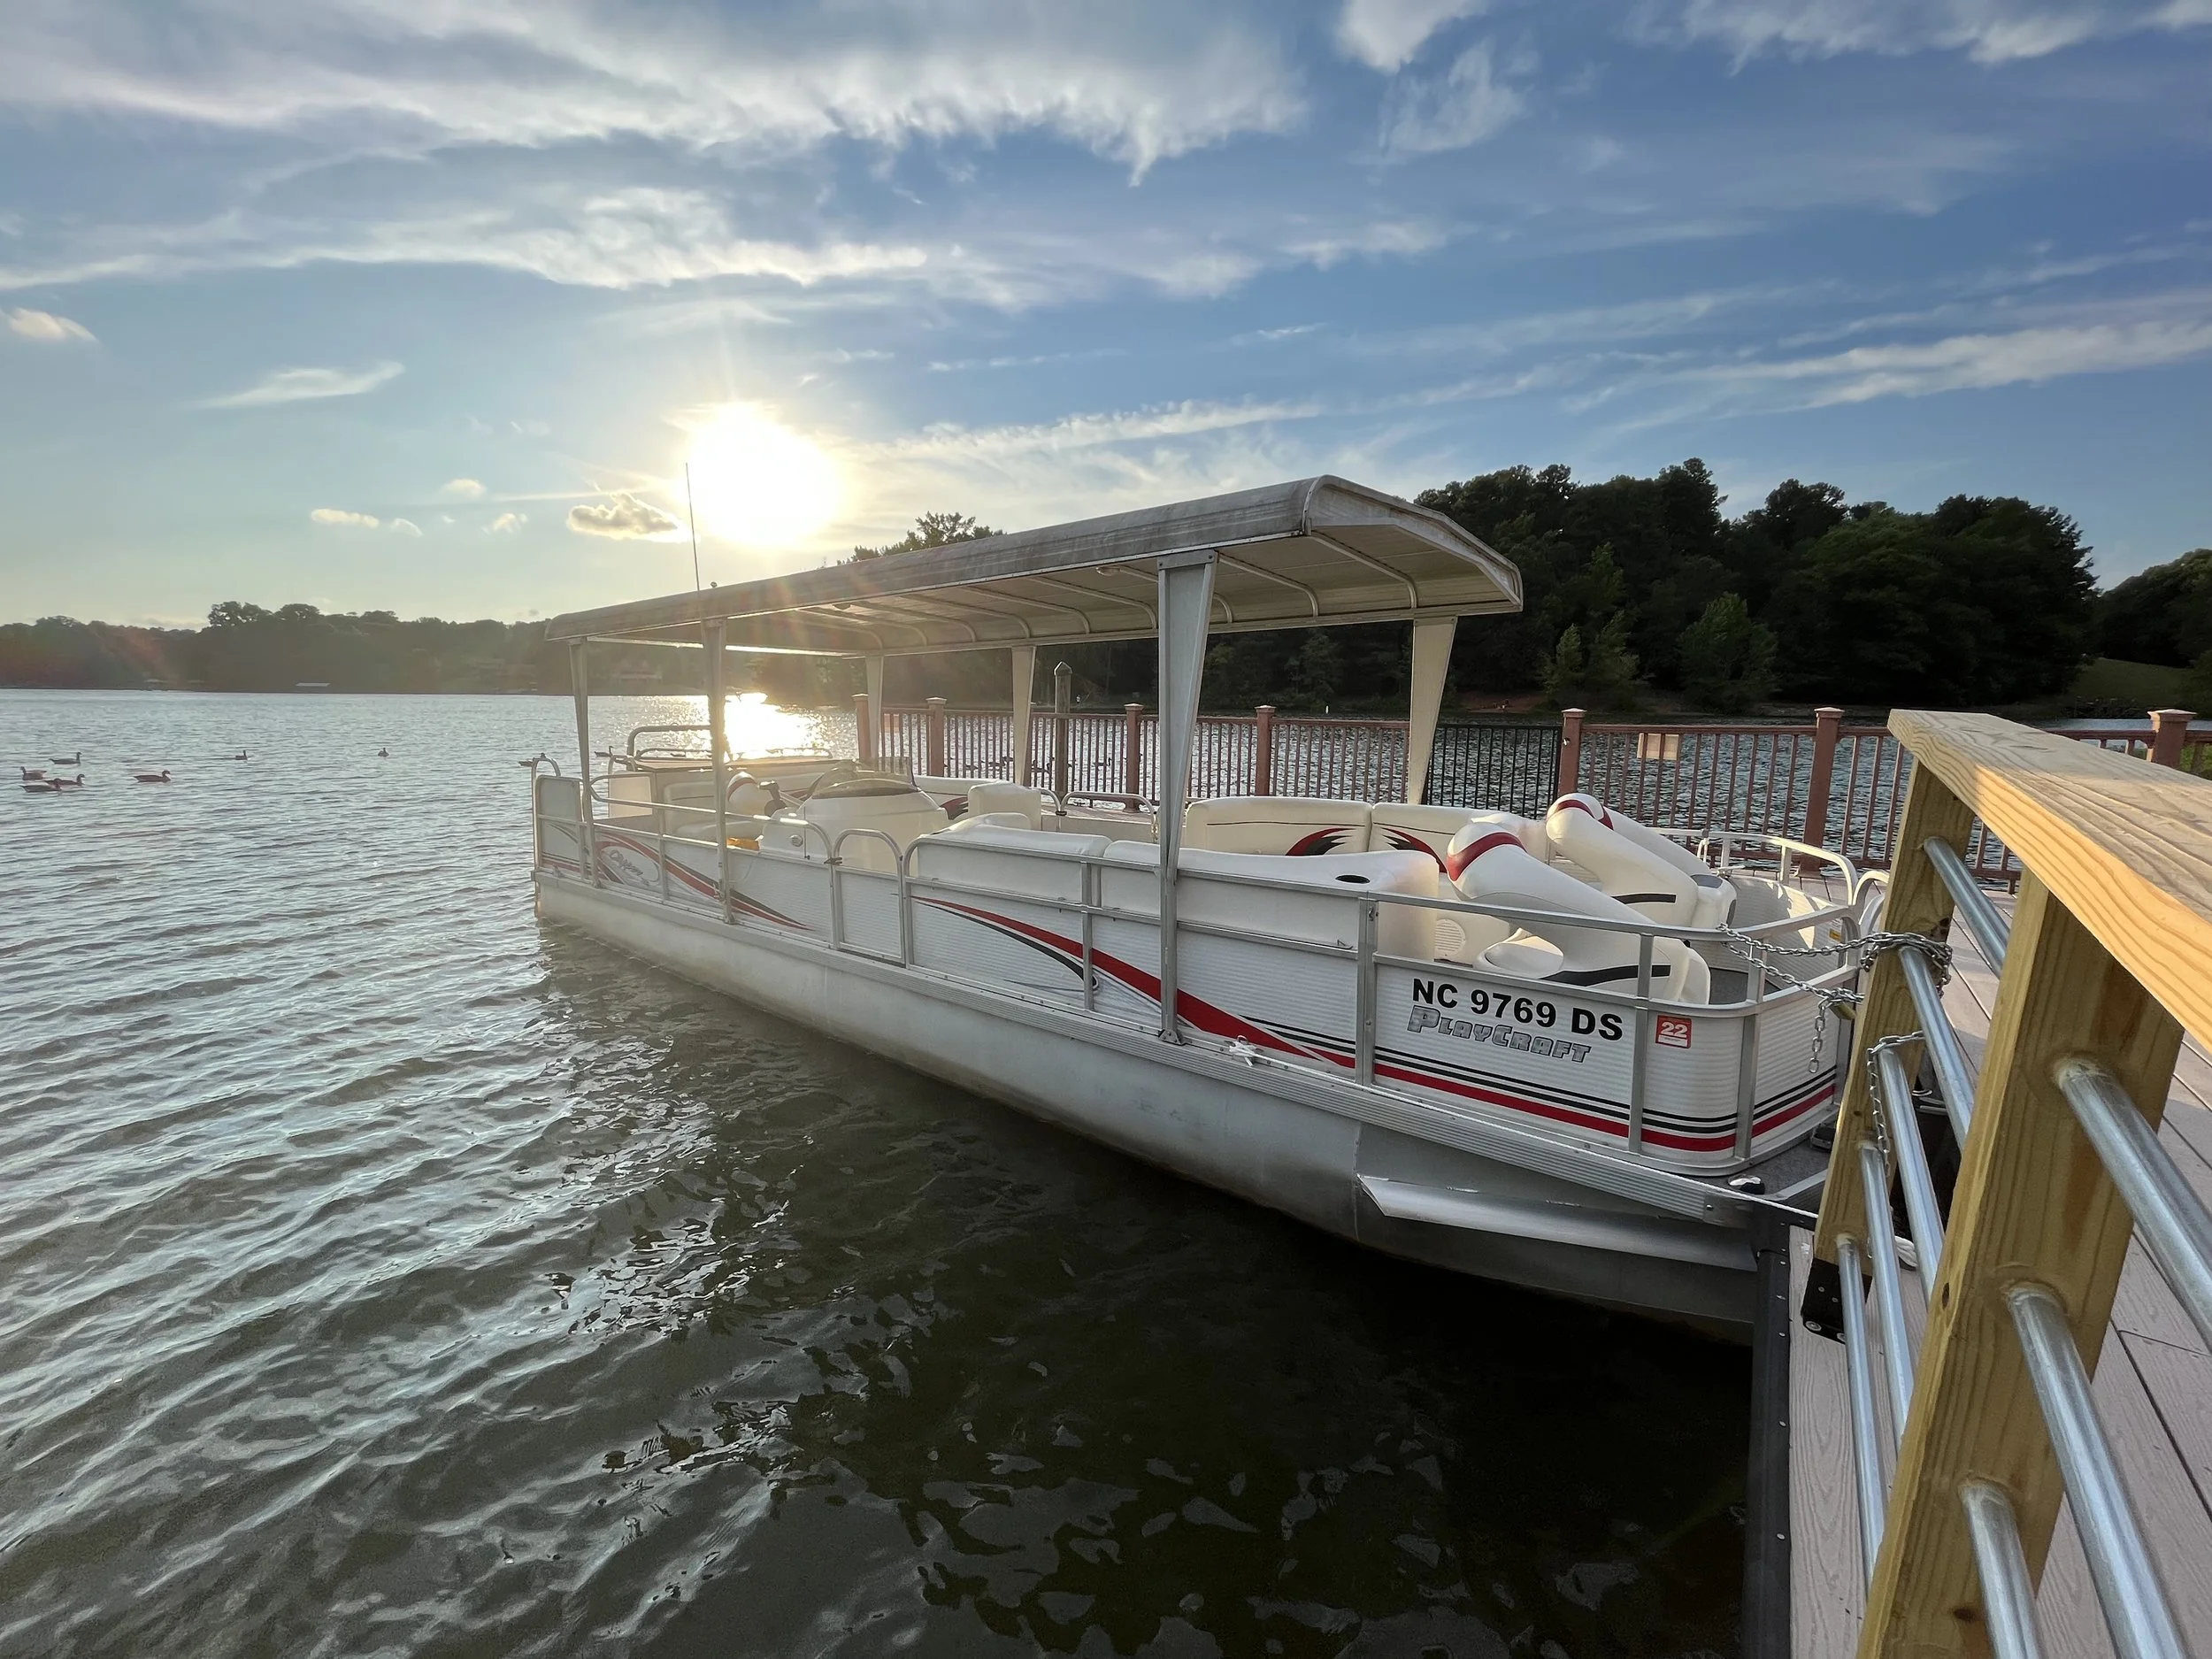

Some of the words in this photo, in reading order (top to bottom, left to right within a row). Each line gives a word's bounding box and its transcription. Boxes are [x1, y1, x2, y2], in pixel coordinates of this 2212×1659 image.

[1413, 979, 1457, 1009] NC
[1471, 989, 1556, 1028] 9769
[1571, 1007, 1623, 1041] DS
[1661, 1021, 1687, 1038] 22
